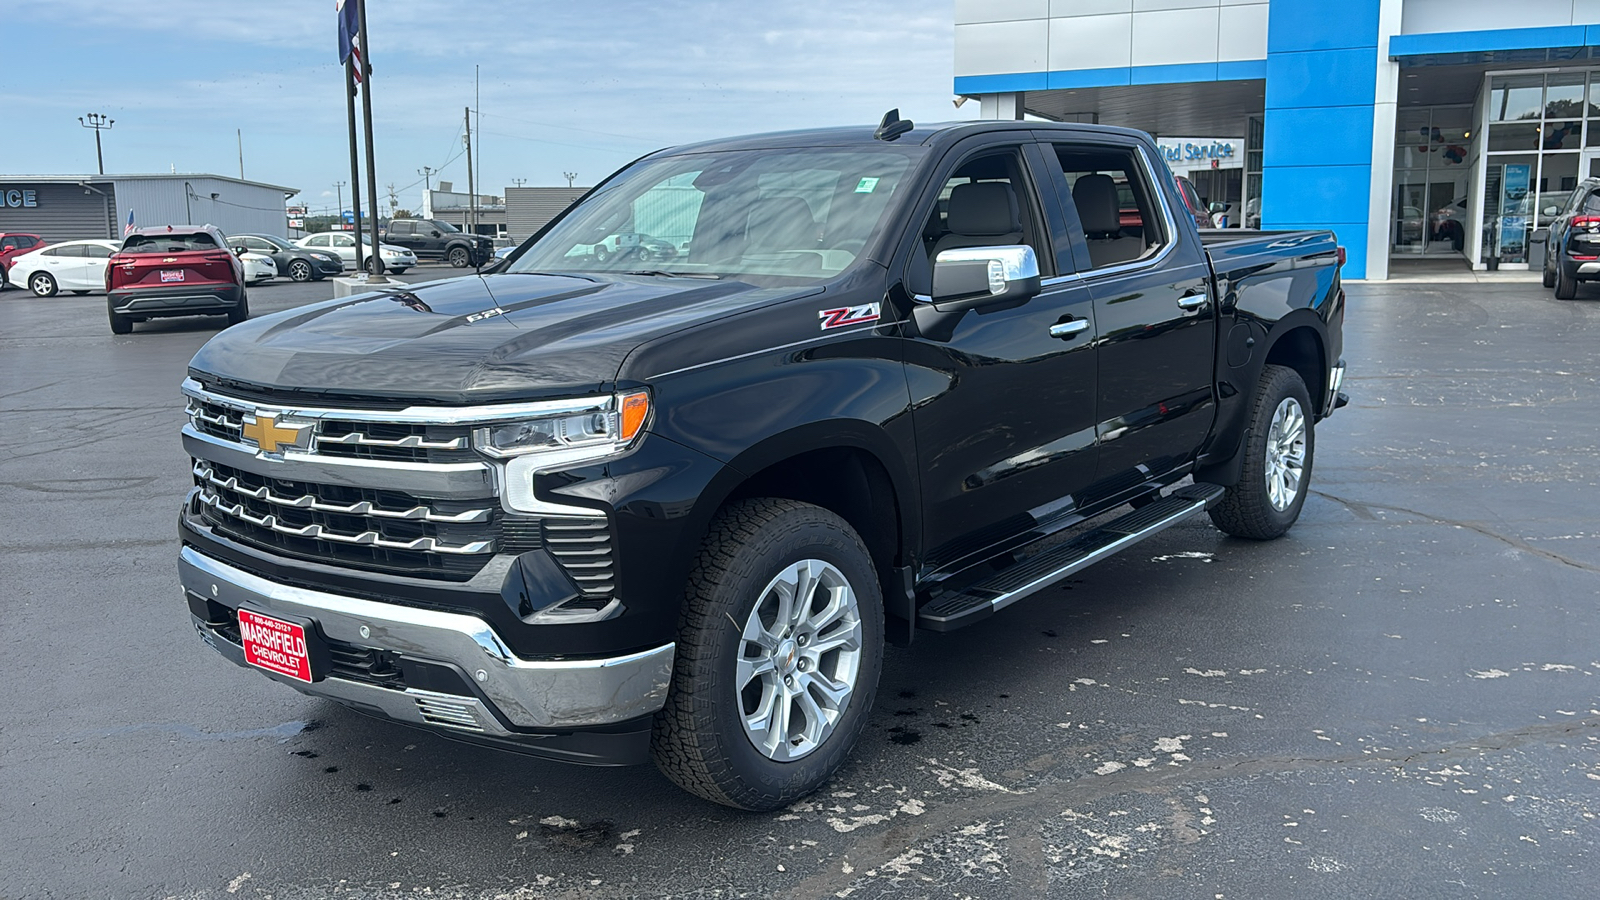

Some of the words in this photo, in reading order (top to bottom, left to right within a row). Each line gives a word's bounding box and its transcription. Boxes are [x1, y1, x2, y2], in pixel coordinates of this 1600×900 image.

[1185, 141, 1232, 160] Service
[0, 189, 37, 207] ICE
[818, 302, 880, 330] Z71
[241, 621, 306, 658] MARSHFIELD
[251, 644, 300, 669] CHEVROLET
